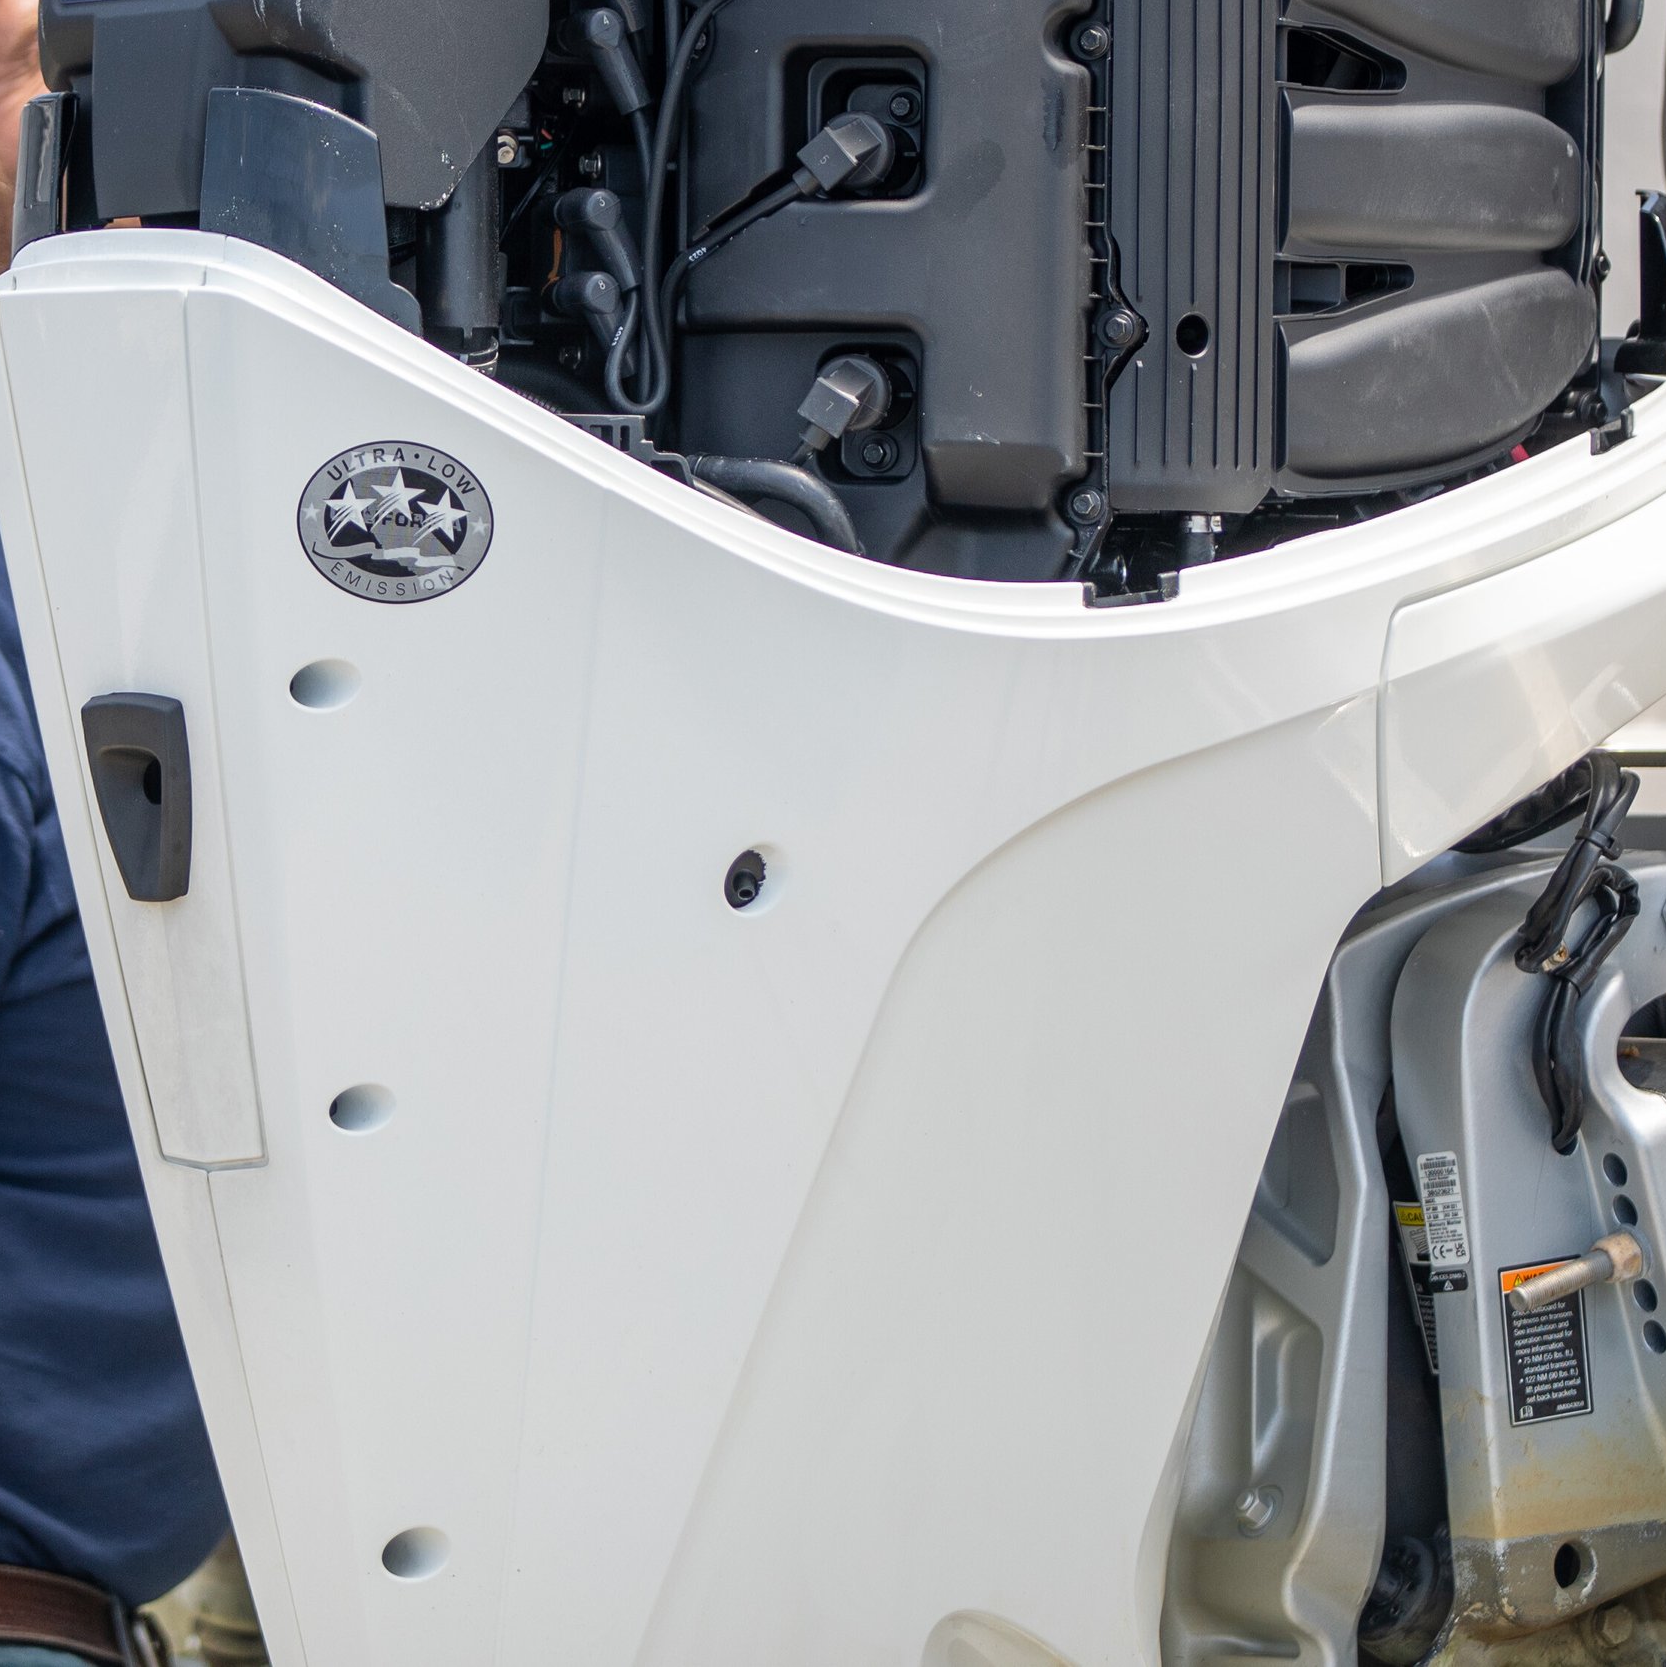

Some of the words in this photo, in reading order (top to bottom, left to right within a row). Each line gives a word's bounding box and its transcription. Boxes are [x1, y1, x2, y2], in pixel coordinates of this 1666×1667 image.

[819, 154, 830, 165] 5
[326, 447, 407, 483] ULTRA
[427, 455, 477, 496] LOW
[330, 561, 455, 597] EMISSION
[1432, 1244, 1446, 1260] CE
[1557, 1301, 1566, 1309] for
[1513, 1316, 1540, 1327] tightness
[1514, 1328, 1526, 1336] See
[1526, 1322, 1557, 1334] installation
[1557, 1320, 1570, 1328] and
[1514, 1335, 1542, 1346] operation
[1542, 1331, 1564, 1340] manual
[1564, 1329, 1573, 1337] for
[1523, 1363, 1550, 1374] standard
[1549, 1359, 1577, 1369] transoms
[1525, 1376, 1536, 1384] 122
[1536, 1374, 1548, 1382] NM
[1525, 1385, 1533, 1393] lift
[1533, 1383, 1552, 1393] plates
[1552, 1380, 1565, 1388] and
[1564, 1377, 1581, 1386] metal
[1526, 1395, 1536, 1404] set
[1536, 1392, 1551, 1401] back
[1551, 1388, 1578, 1399] brackets
